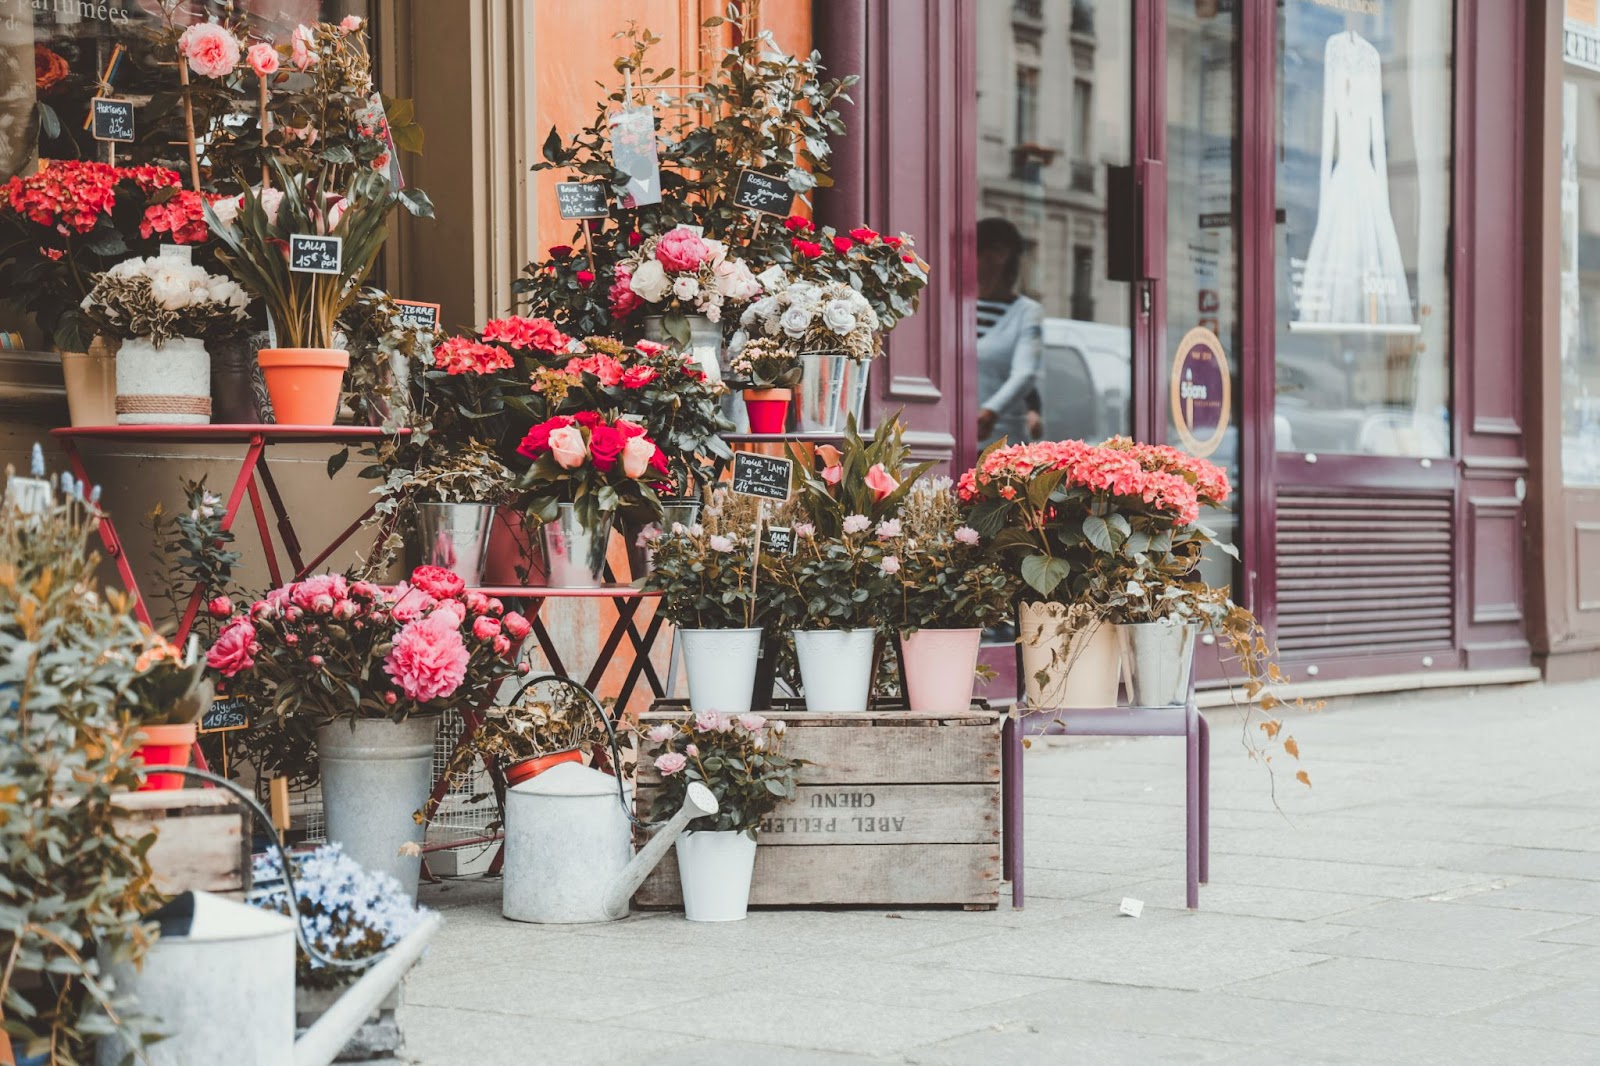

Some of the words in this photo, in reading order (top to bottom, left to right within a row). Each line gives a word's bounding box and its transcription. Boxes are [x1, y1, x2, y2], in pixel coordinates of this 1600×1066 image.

[298, 240, 327, 251] CALLA
[210, 698, 246, 714] olygala
[811, 792, 876, 808] CHENU
[851, 816, 906, 833] ABEL
